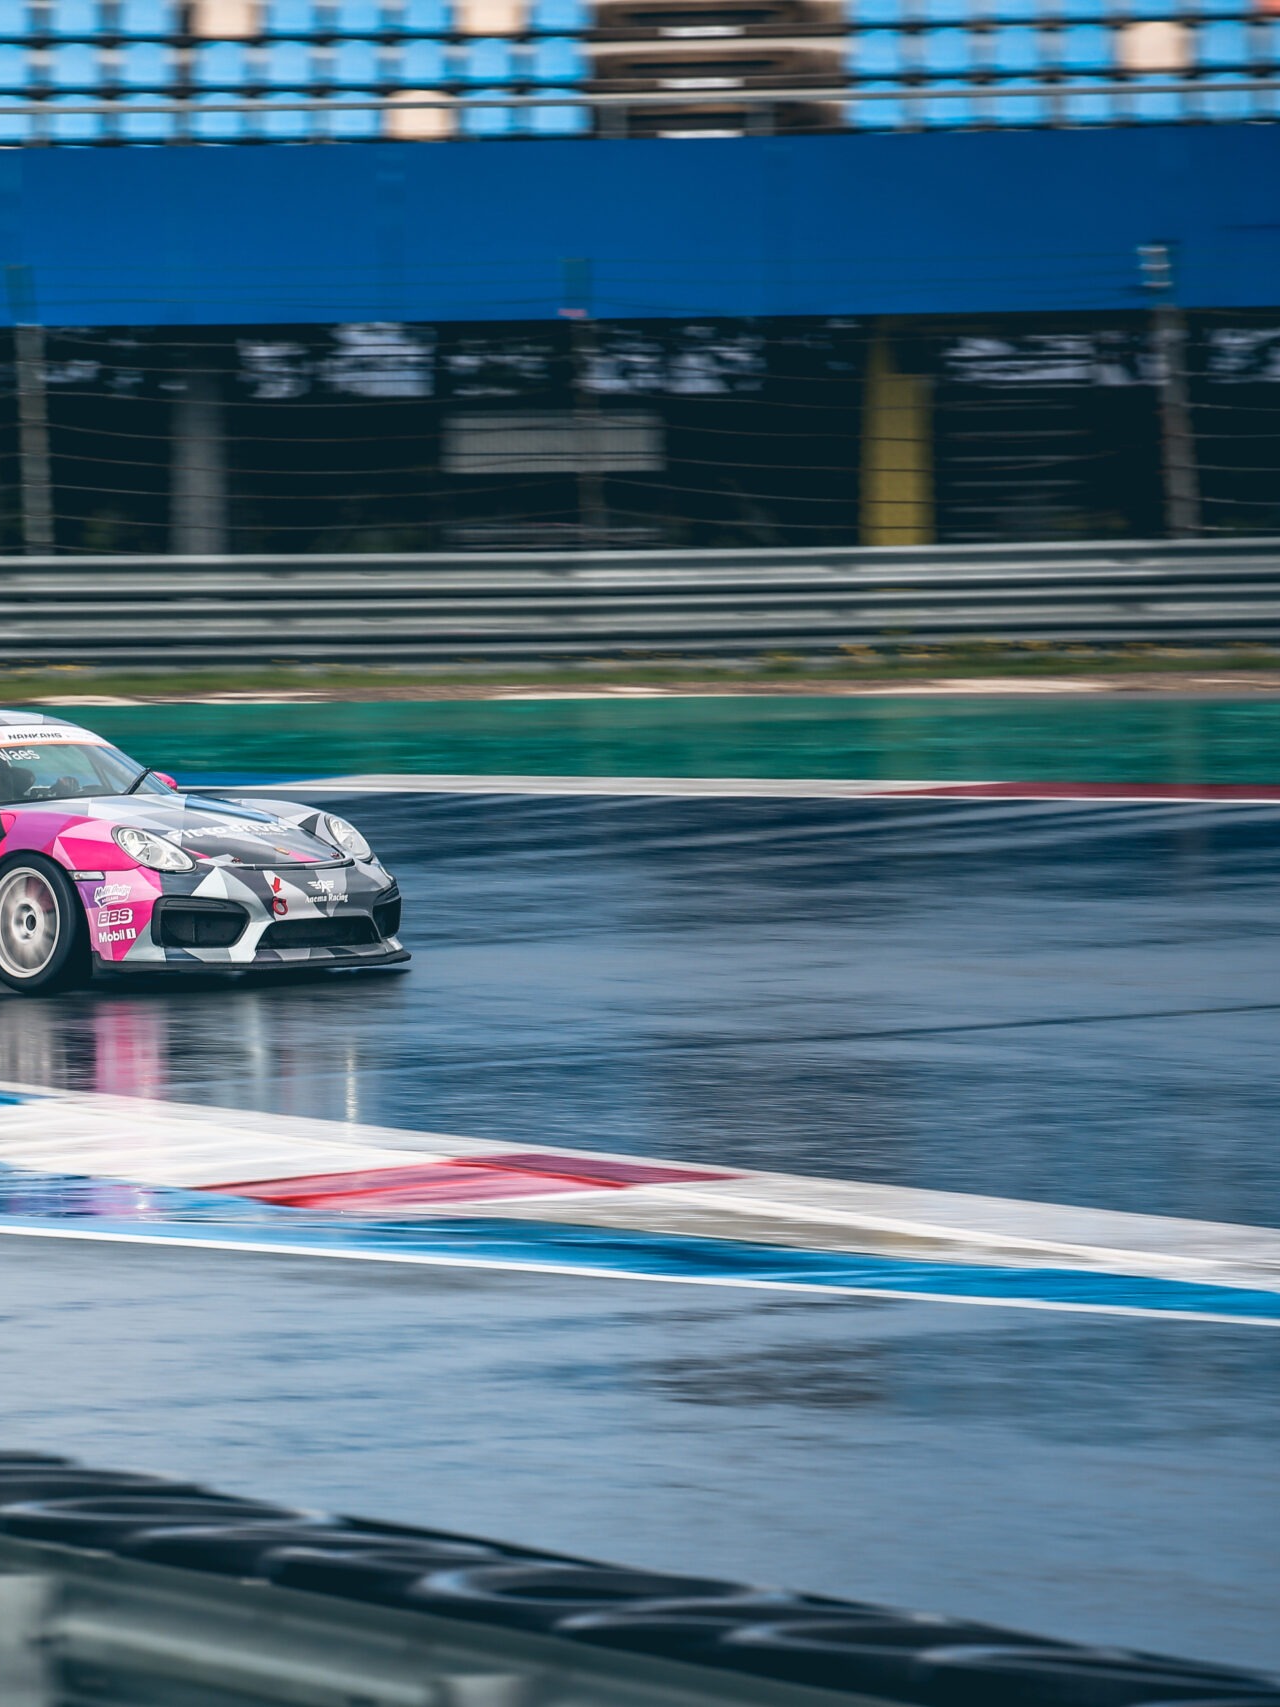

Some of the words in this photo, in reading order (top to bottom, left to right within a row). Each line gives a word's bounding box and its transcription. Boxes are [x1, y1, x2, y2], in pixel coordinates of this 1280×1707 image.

[7, 732, 62, 740] NANKANG
[329, 893, 349, 903] Racing
[99, 909, 130, 925] BBS
[99, 929, 125, 943] Mobil
